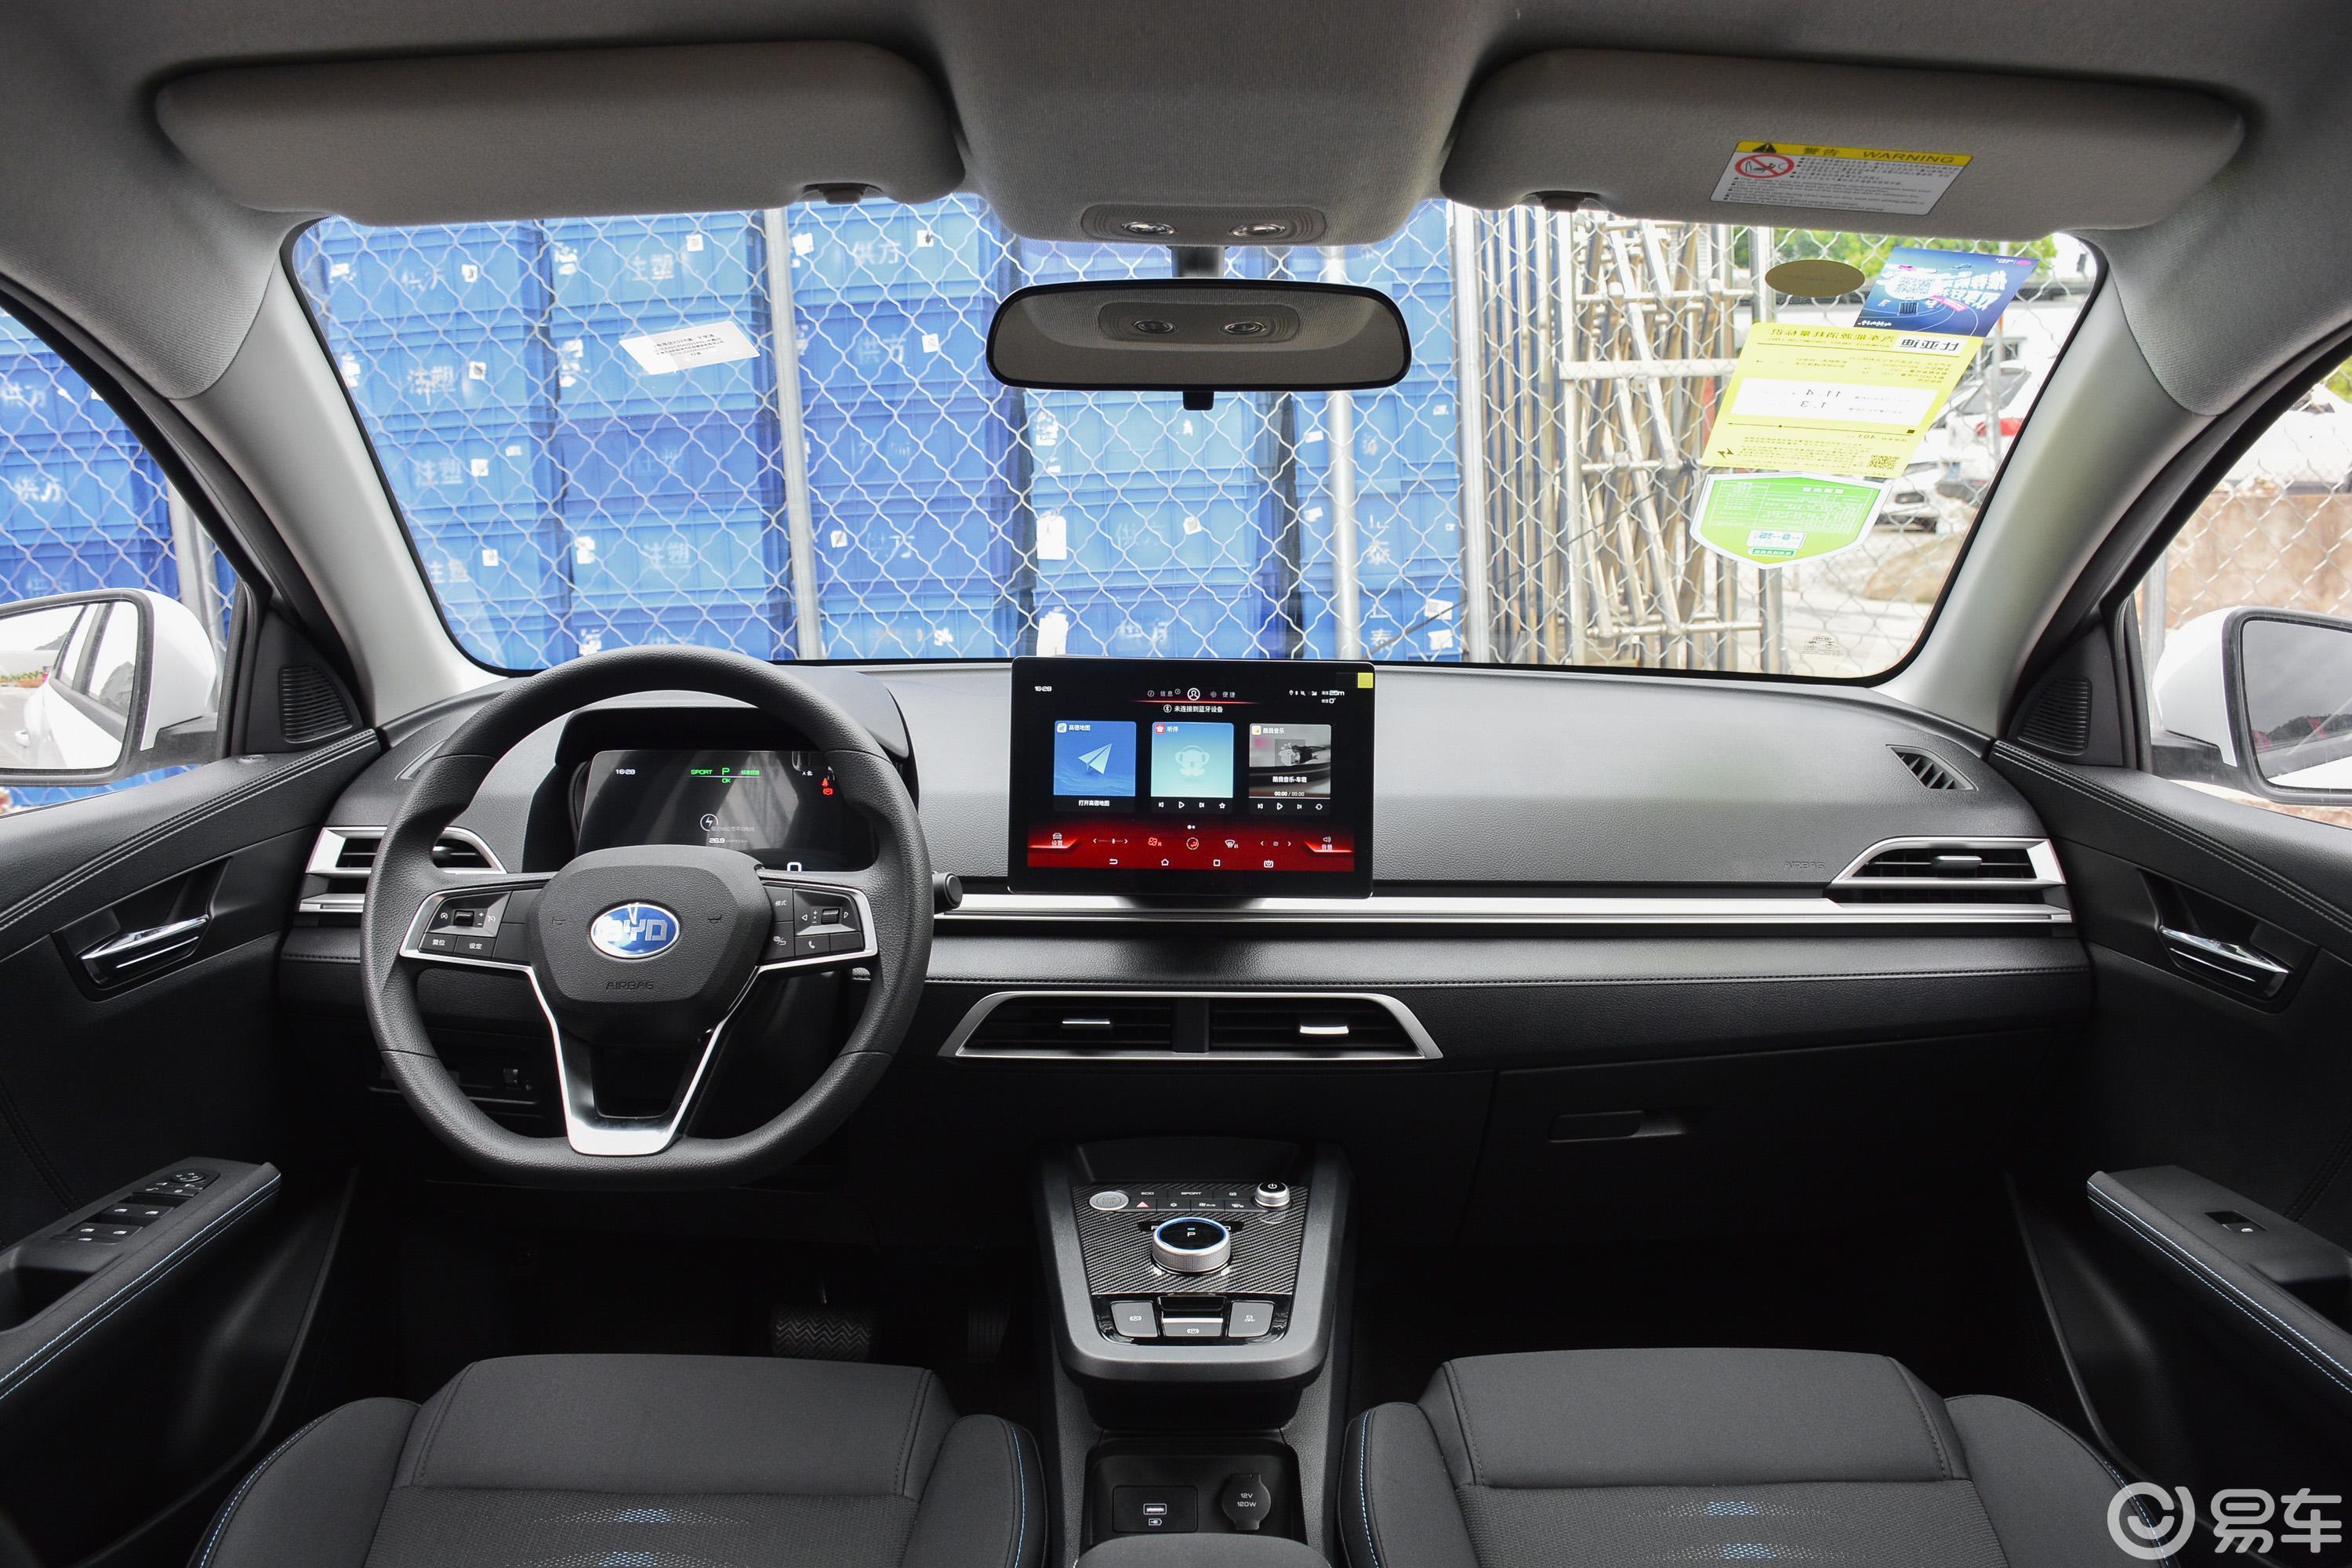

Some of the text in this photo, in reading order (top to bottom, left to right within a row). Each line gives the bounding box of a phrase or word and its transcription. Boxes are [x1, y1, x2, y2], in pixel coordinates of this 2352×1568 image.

[1802, 146, 1955, 164] 警告 WARNING
[721, 767, 731, 775] P
[606, 982, 654, 990] AIRBAG
